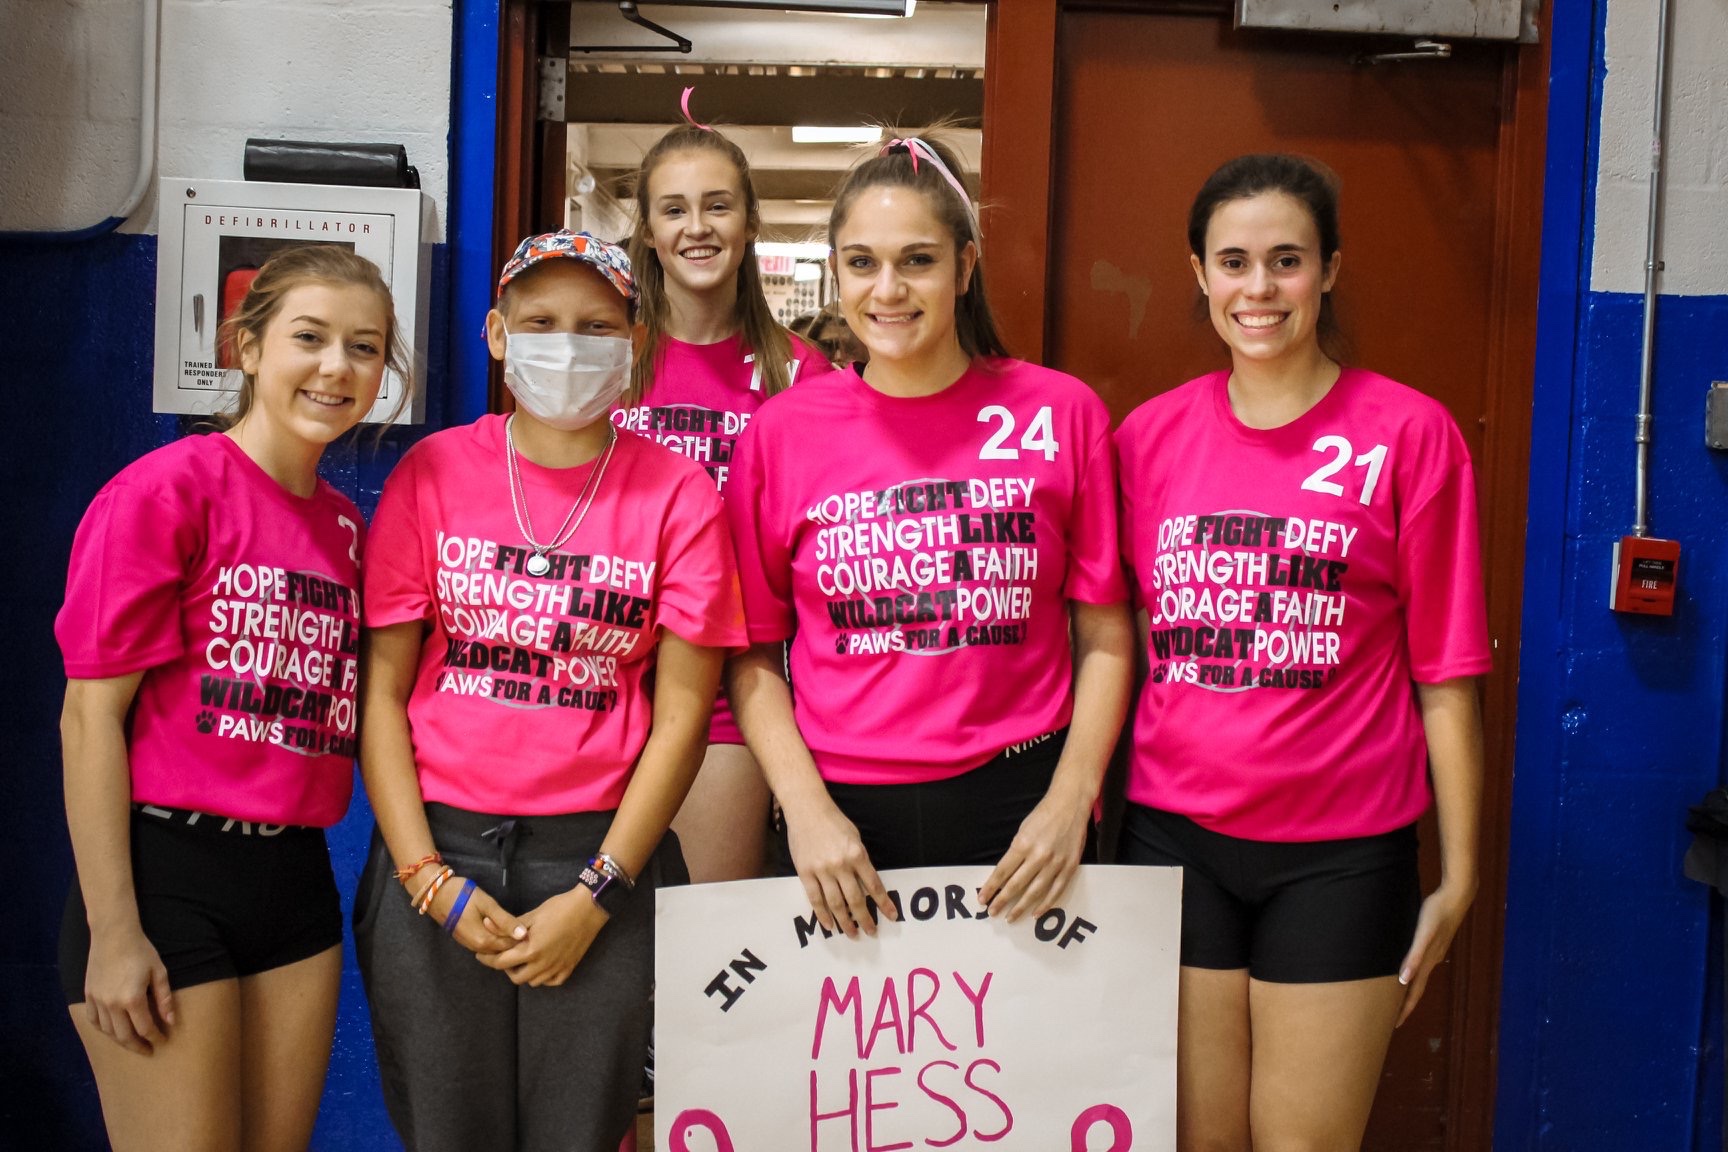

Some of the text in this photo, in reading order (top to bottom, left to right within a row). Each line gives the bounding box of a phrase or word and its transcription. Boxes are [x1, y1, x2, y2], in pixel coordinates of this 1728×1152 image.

[205, 215, 370, 234] DEFIBRILLATOR
[184, 361, 213, 369] TRAINED
[184, 369, 227, 378] RESPONDERS
[197, 378, 213, 386] ONLY
[610, 406, 752, 435] OPE FIGHT DE
[976, 405, 1060, 462] 24
[1300, 435, 1389, 507] 21
[806, 477, 1036, 525] HOPE FIGHT DEFY
[815, 512, 1036, 561] STRENGTH LIKE
[1194, 515, 1287, 548] FIGHT
[1284, 517, 1358, 558] DEFY
[212, 563, 286, 601] HOPE
[286, 571, 349, 614] FIGHT
[495, 545, 590, 580] FIHT
[589, 555, 656, 594] DEFY
[817, 547, 1038, 597] COURAGE A FAITH
[1152, 549, 1349, 592] STRENGTH LIKE
[1642, 580, 1657, 590] FIRE
[436, 567, 651, 629] STRENGTH LIKE
[827, 587, 1032, 629] WILDCAT POWER
[1254, 592, 1273, 623] A
[1272, 590, 1346, 626] FAITH
[209, 600, 344, 650] STRENGTH
[551, 622, 571, 653] A
[570, 621, 640, 656] FAITH
[849, 630, 906, 655] PAWS
[904, 628, 940, 650] FOR
[946, 626, 960, 647] A
[205, 637, 333, 687] COURAGE
[1253, 629, 1341, 665] POWER
[441, 673, 607, 712] AWS FOR A CAUE
[1200, 664, 1236, 686] FOR
[1241, 667, 1254, 687] A
[1259, 667, 1323, 689] CAUSE
[200, 674, 332, 724] WILDCAT
[218, 715, 283, 744] PAWS
[284, 726, 316, 750] FOR
[703, 948, 768, 1013] IN
[1034, 907, 1098, 950] OF
[811, 967, 993, 1060] MARY
[809, 1058, 1014, 1152] HESS
